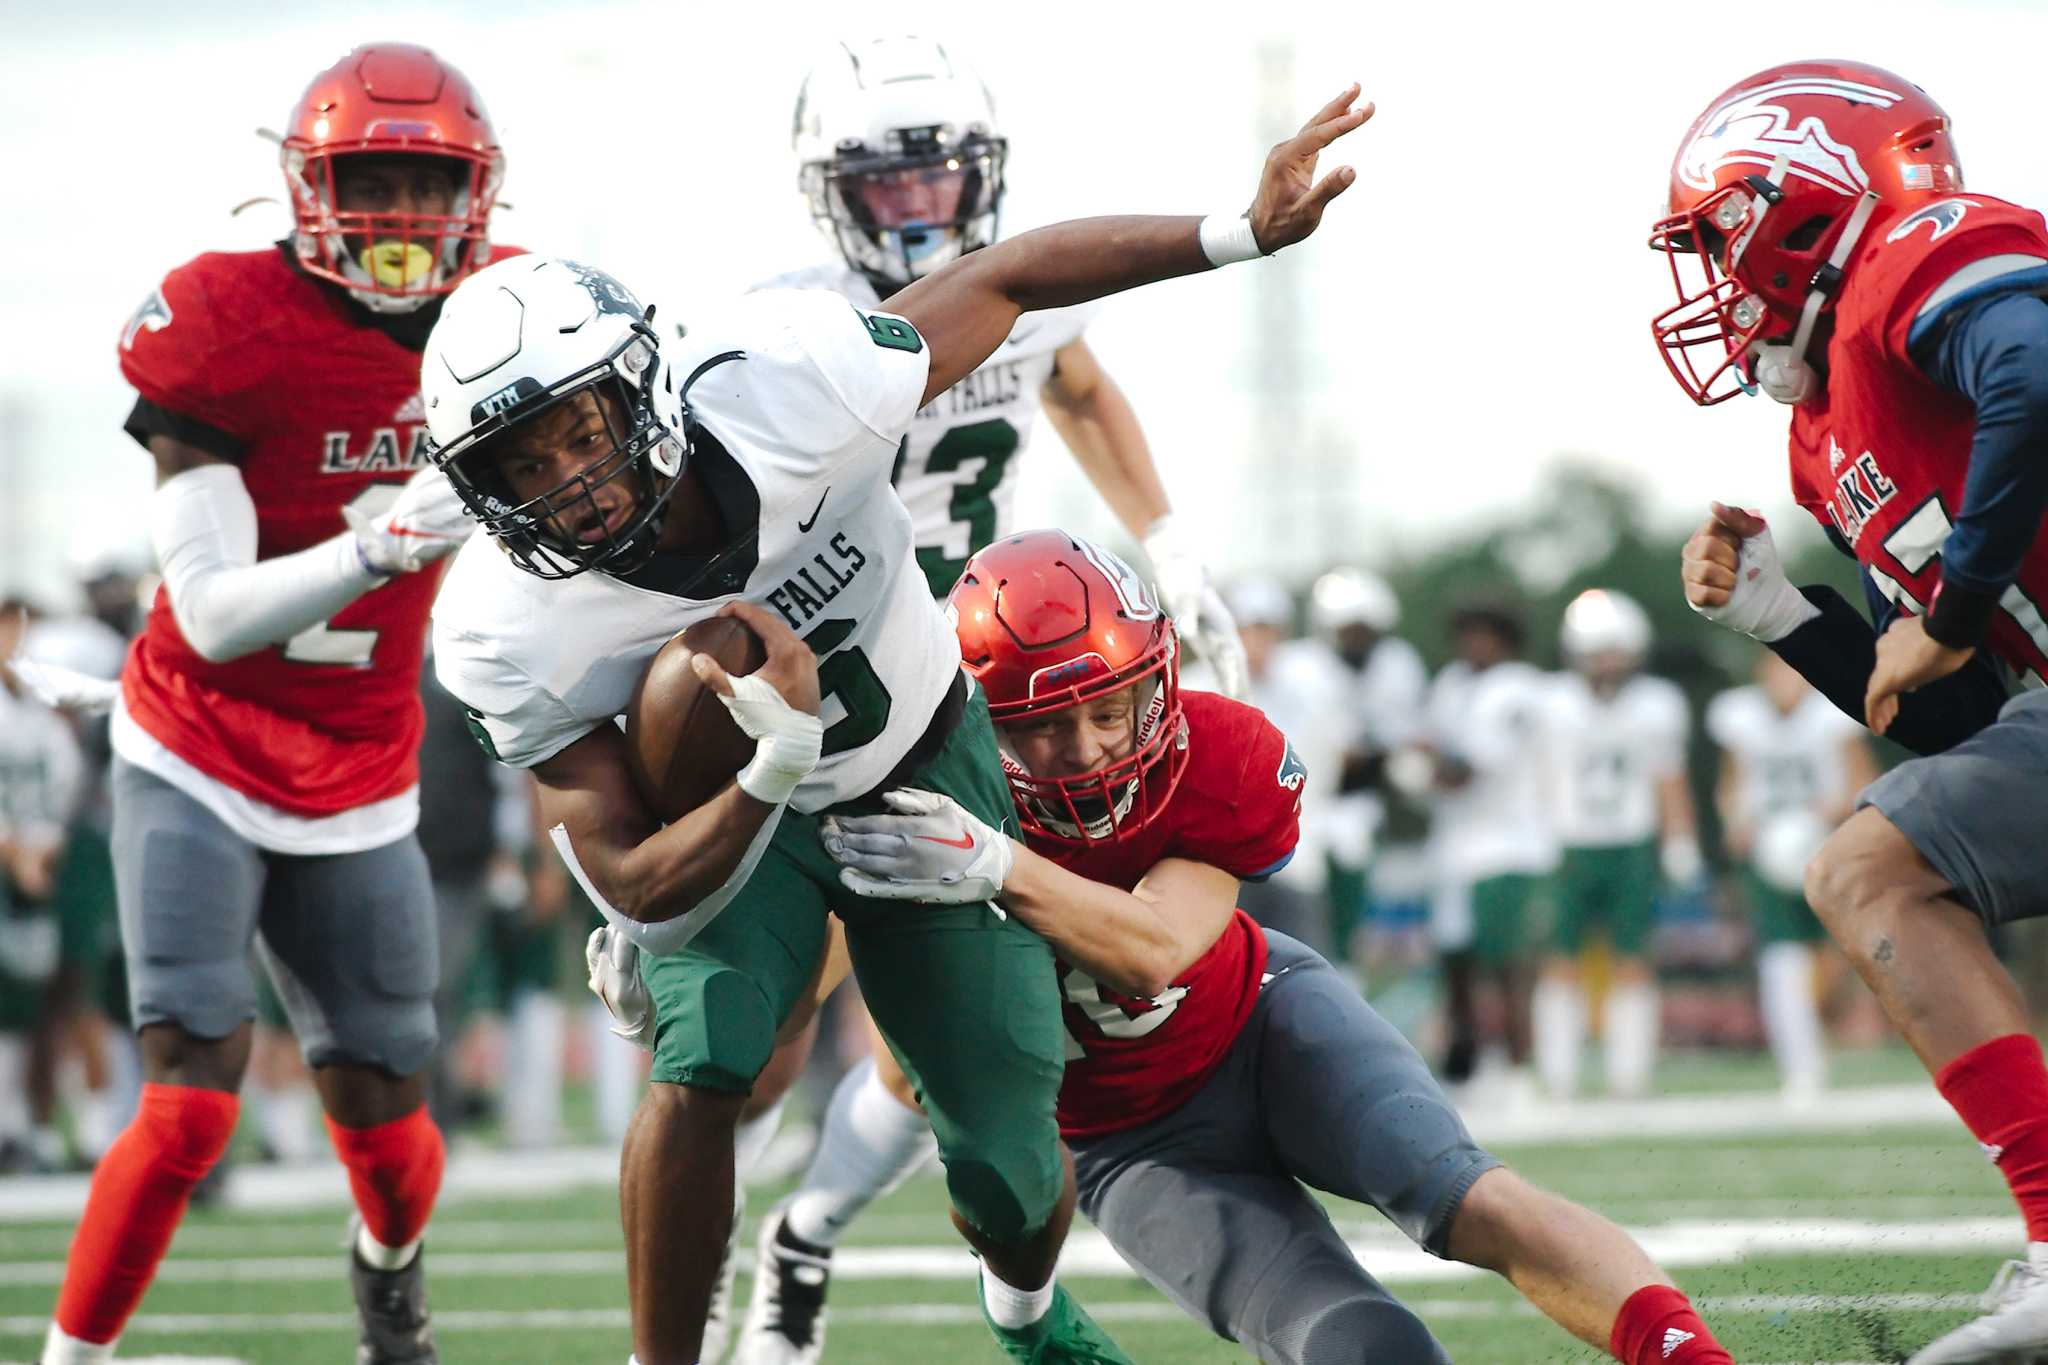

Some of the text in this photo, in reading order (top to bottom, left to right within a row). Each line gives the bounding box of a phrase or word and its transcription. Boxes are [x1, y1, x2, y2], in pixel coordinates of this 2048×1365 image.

[1826, 450, 1898, 549] LAKE
[765, 531, 866, 630] FALLS
[1136, 696, 1165, 748] Riddell
